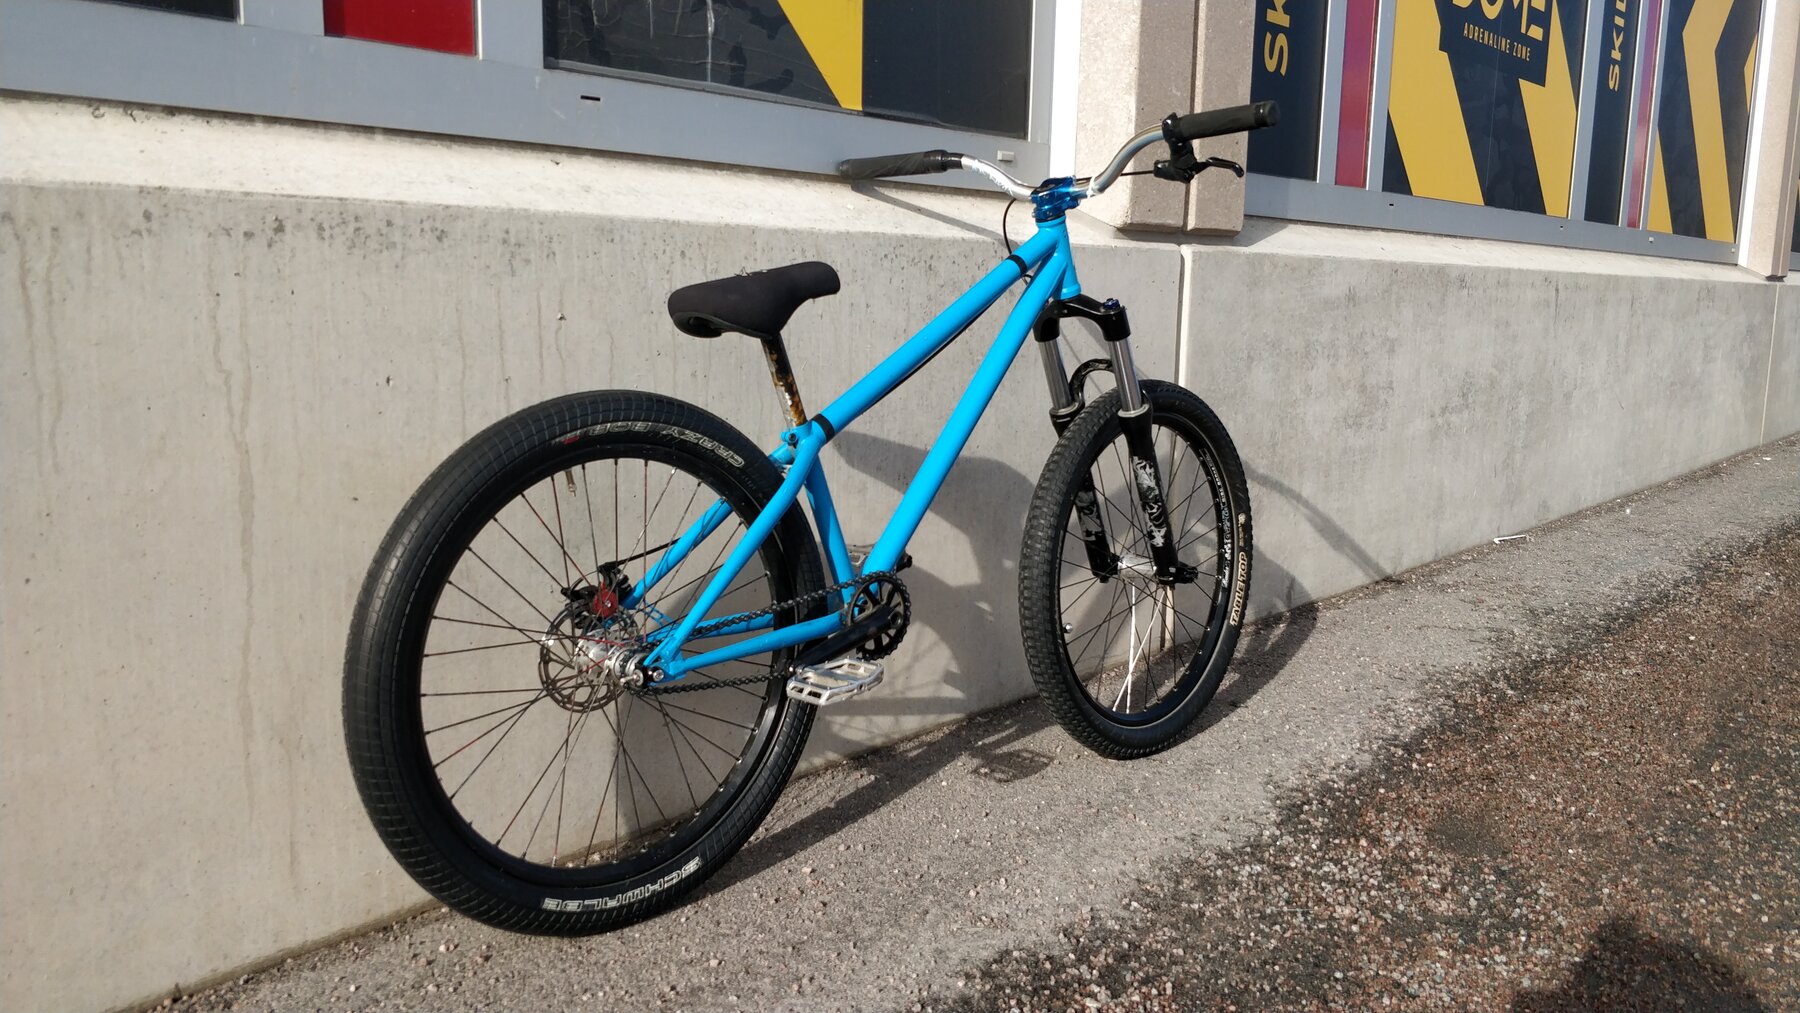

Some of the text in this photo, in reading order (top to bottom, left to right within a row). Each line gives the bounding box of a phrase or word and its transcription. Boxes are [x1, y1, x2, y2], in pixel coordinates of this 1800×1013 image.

[1452, 0, 1545, 41] ME
[1463, 22, 1531, 61] ADRENALINE ZONE
[590, 421, 746, 468] CRAZY BOB
[1230, 580, 1245, 625] TABLE
[1239, 552, 1247, 580] TOP
[541, 856, 702, 912] SCHWALBE
